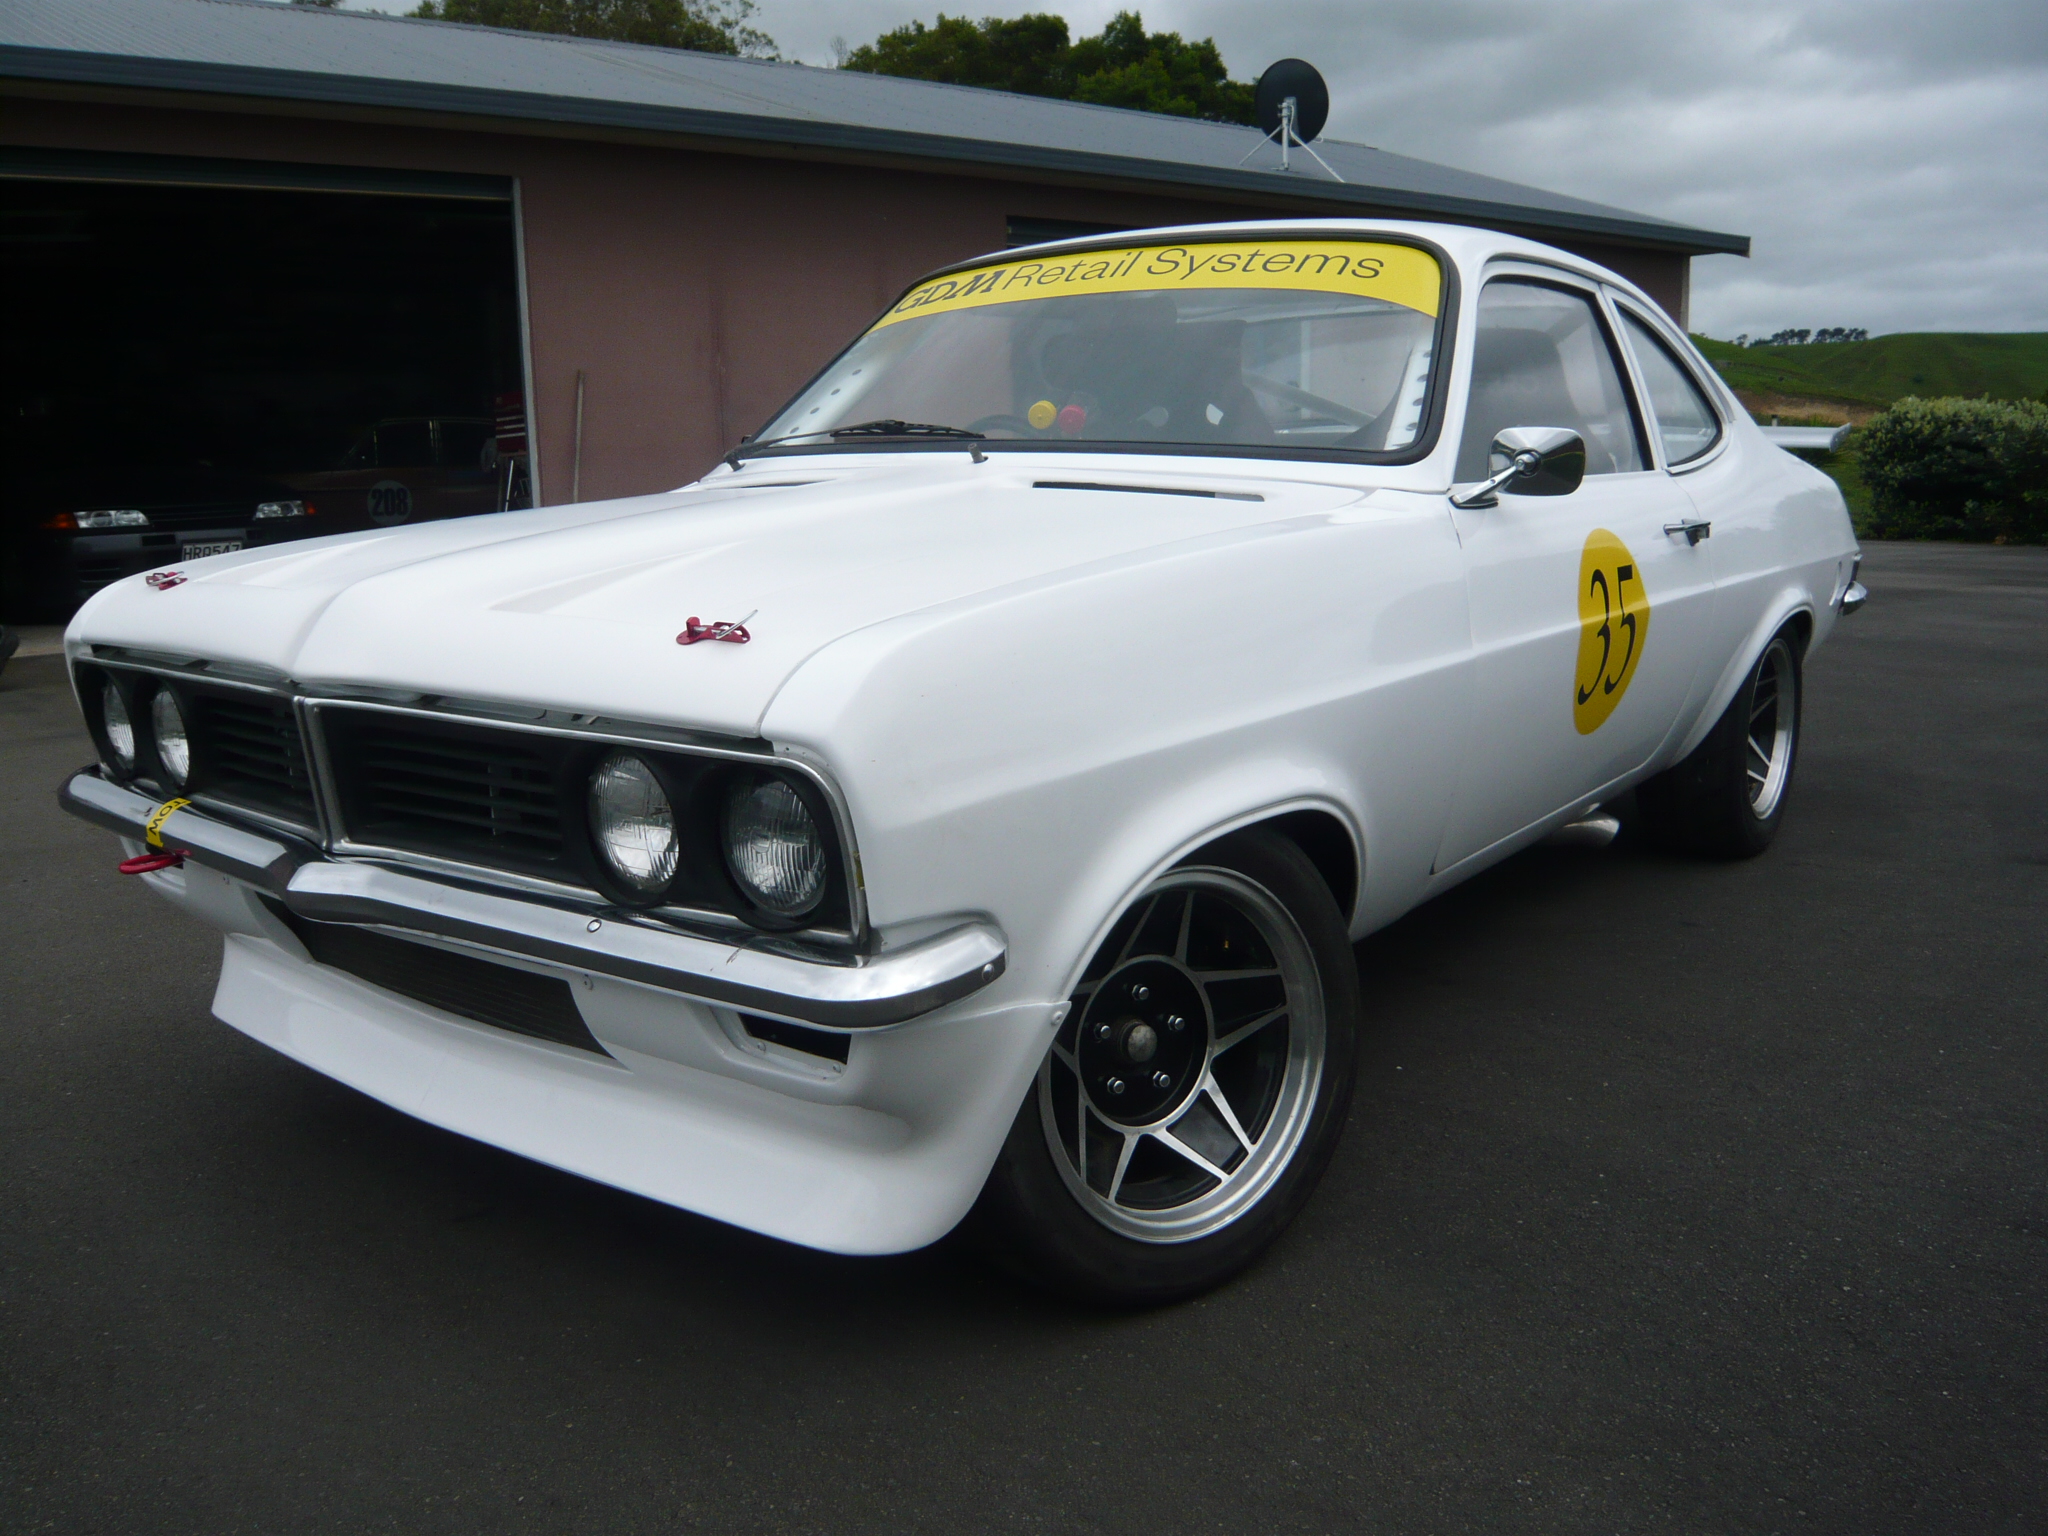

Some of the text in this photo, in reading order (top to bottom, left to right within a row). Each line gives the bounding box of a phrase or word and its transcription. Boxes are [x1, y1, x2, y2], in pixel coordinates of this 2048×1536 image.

[894, 248, 1385, 314] GDM Retail Systems
[371, 487, 409, 517] 208
[1577, 564, 1636, 706] 35
[148, 800, 188, 836] TOW
